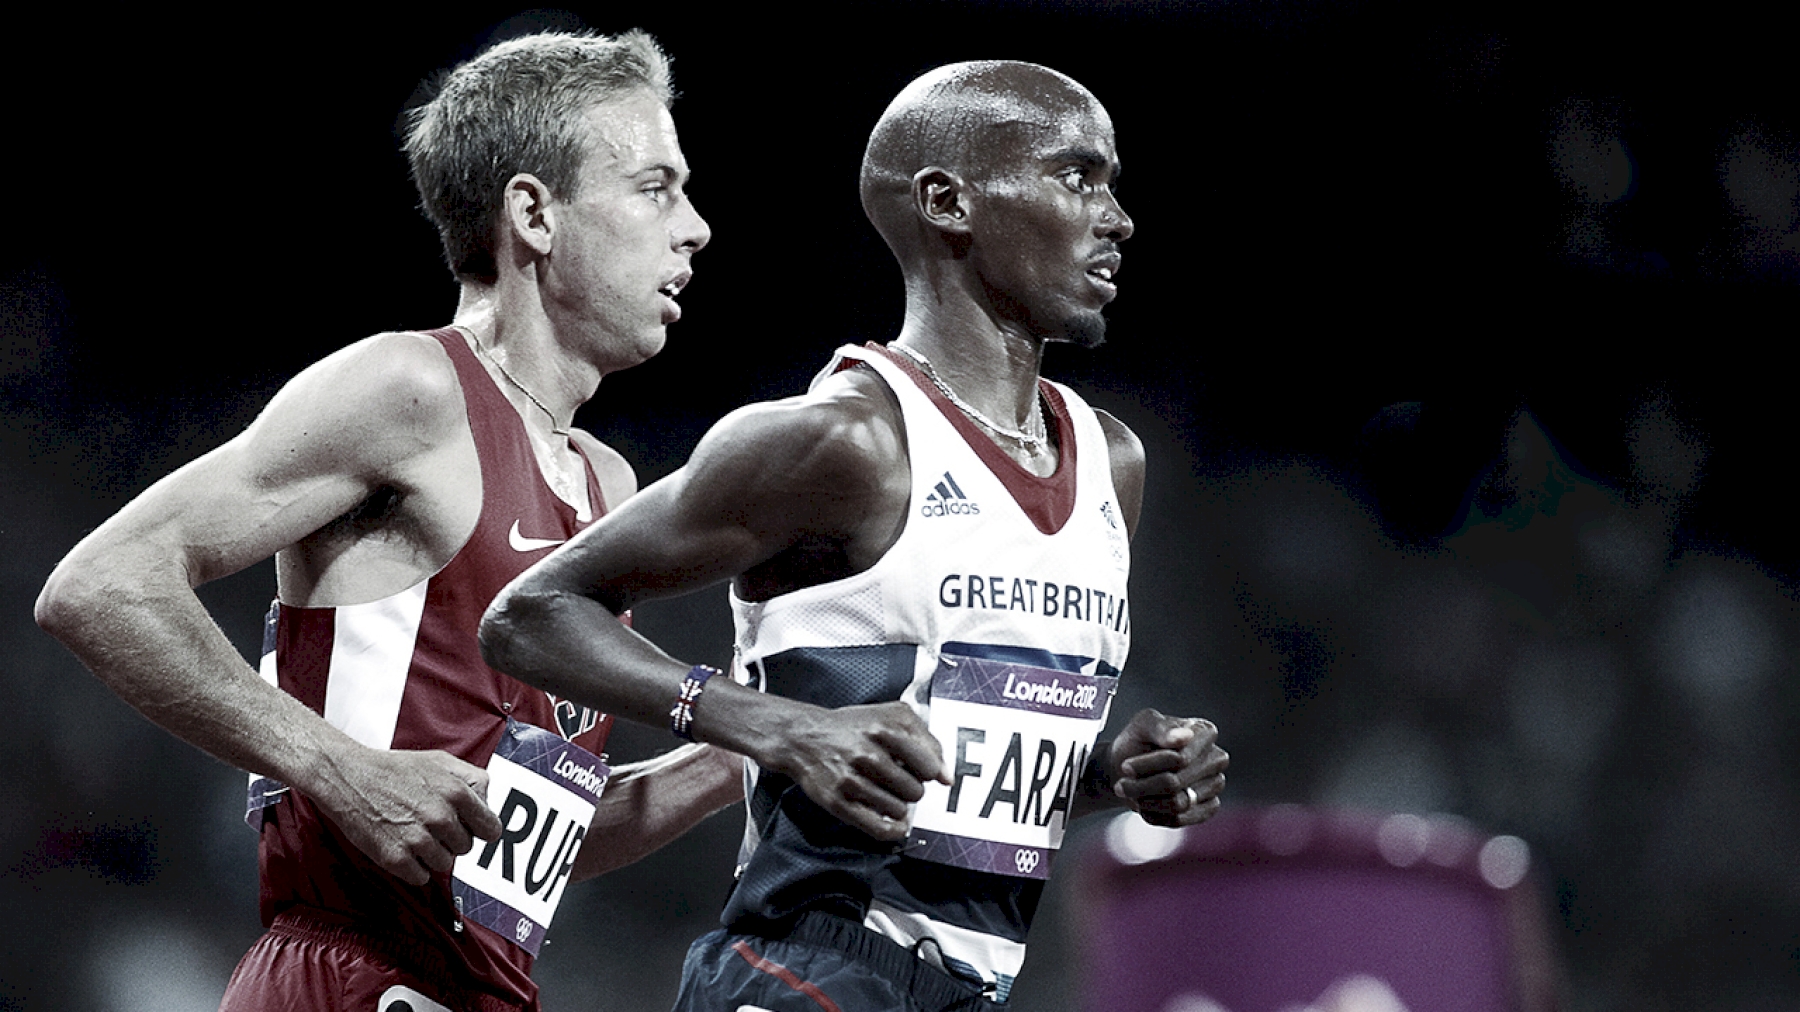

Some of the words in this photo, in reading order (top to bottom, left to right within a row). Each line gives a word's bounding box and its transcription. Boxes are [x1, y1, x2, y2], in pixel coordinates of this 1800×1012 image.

[921, 500, 980, 517] adidas
[939, 574, 1037, 613] GREAT
[1003, 673, 1073, 707] London
[553, 751, 602, 794] London
